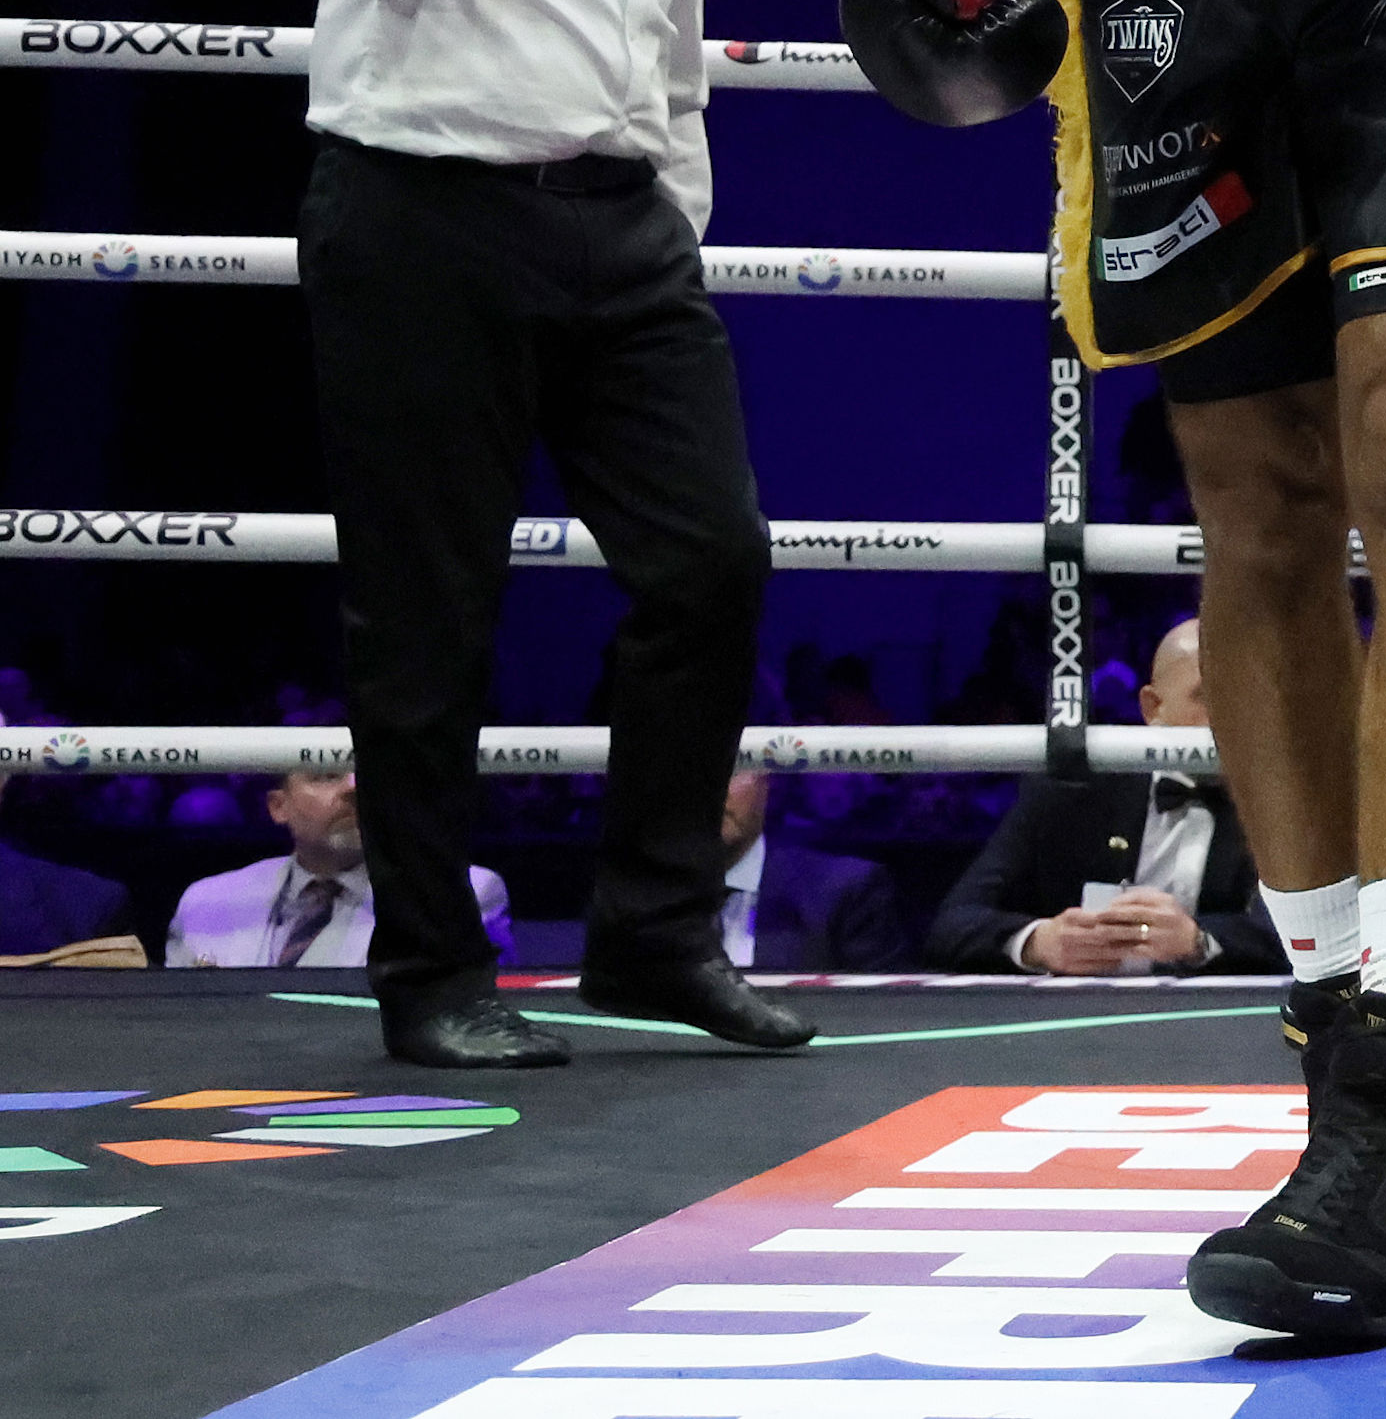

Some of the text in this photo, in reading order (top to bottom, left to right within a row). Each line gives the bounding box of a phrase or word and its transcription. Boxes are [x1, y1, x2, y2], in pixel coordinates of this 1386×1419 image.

[22, 21, 274, 58] BOXXER
[1107, 18, 1175, 68] TWINS
[150, 255, 246, 272] SEASON
[853, 266, 946, 282] SEASON
[1050, 358, 1081, 525] BOXXER
[1049, 561, 1082, 728] BOXXER
[101, 747, 200, 763] SEASON
[819, 749, 913, 764] SEASON
